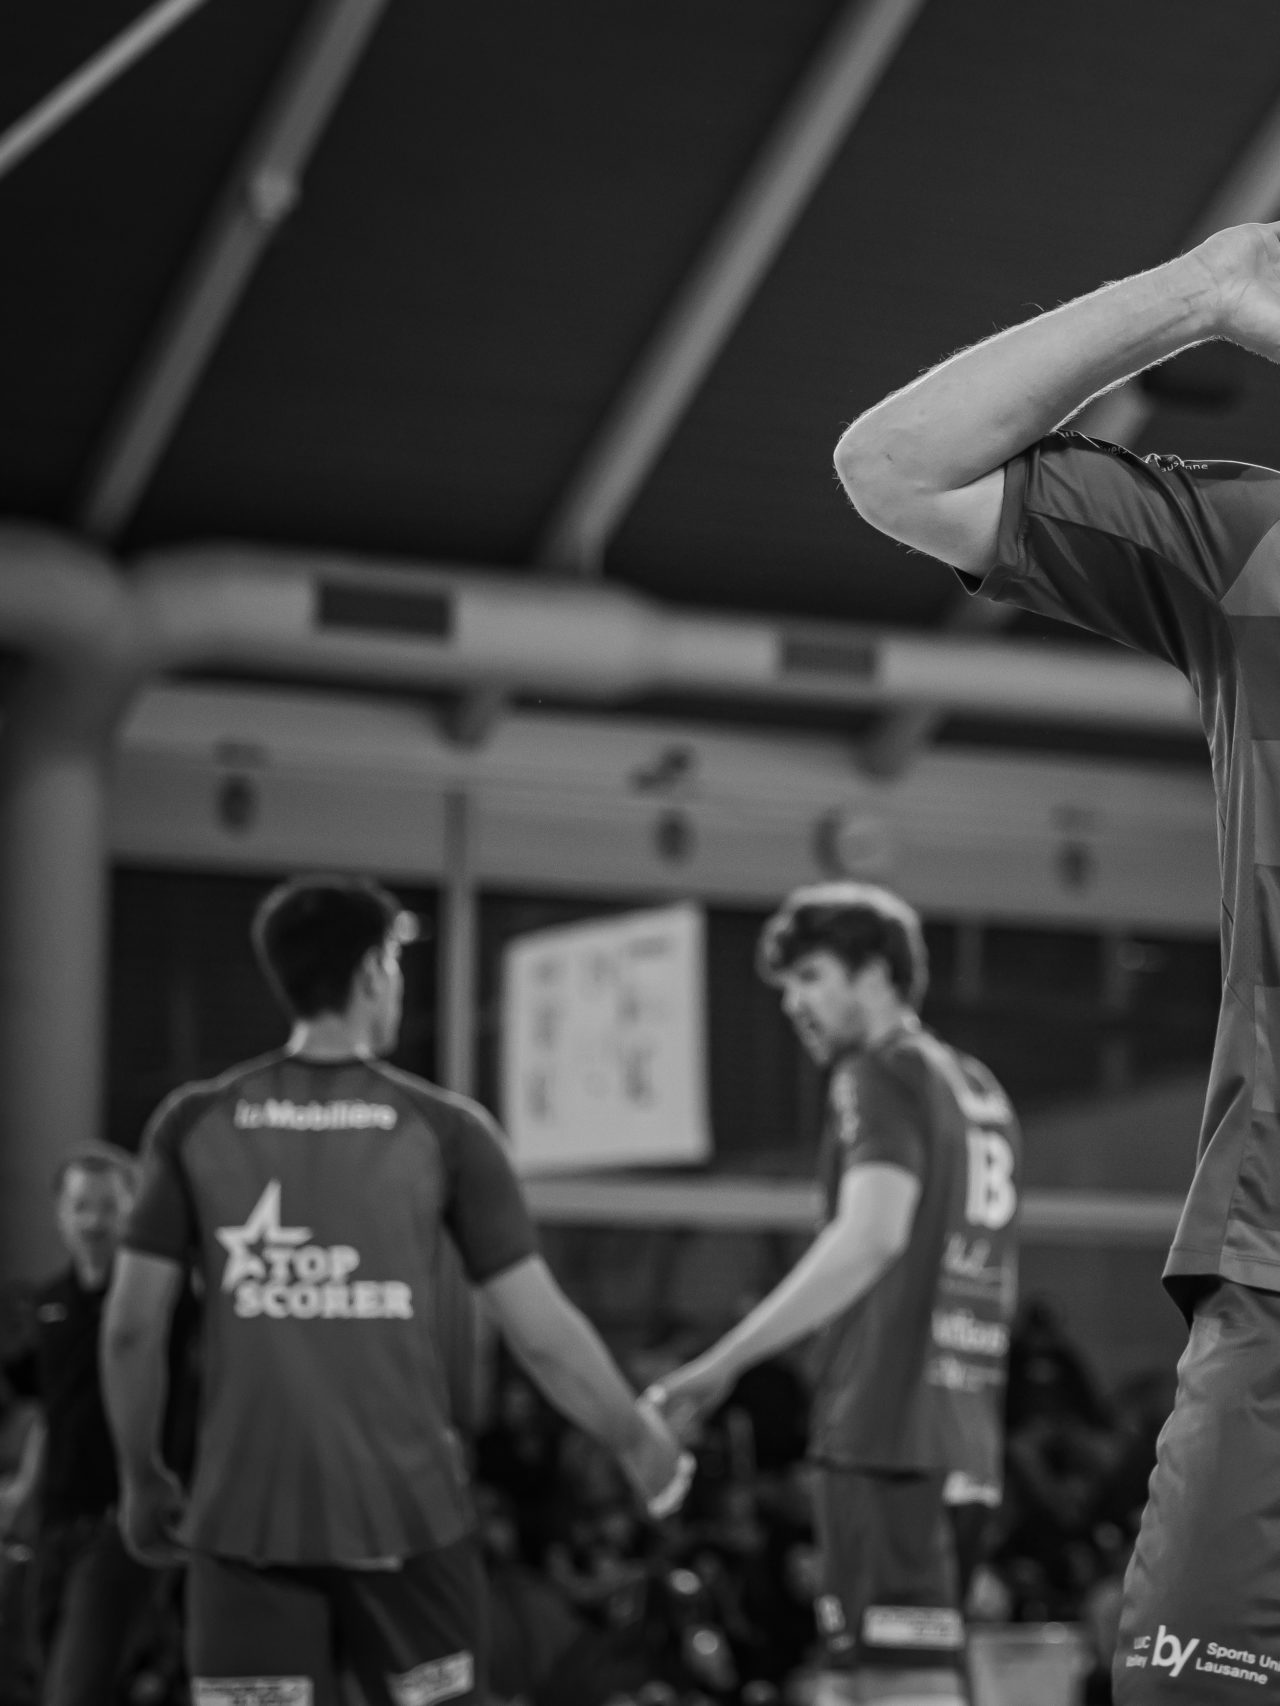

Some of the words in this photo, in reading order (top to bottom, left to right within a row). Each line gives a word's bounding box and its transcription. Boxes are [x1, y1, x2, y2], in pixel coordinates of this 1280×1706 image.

[262, 1245, 361, 1285] TOP
[234, 1280, 414, 1320] SCORER
[1151, 1625, 1200, 1677] by
[1195, 1657, 1268, 1685] Lausanne
[1206, 1642, 1256, 1664] Sports
